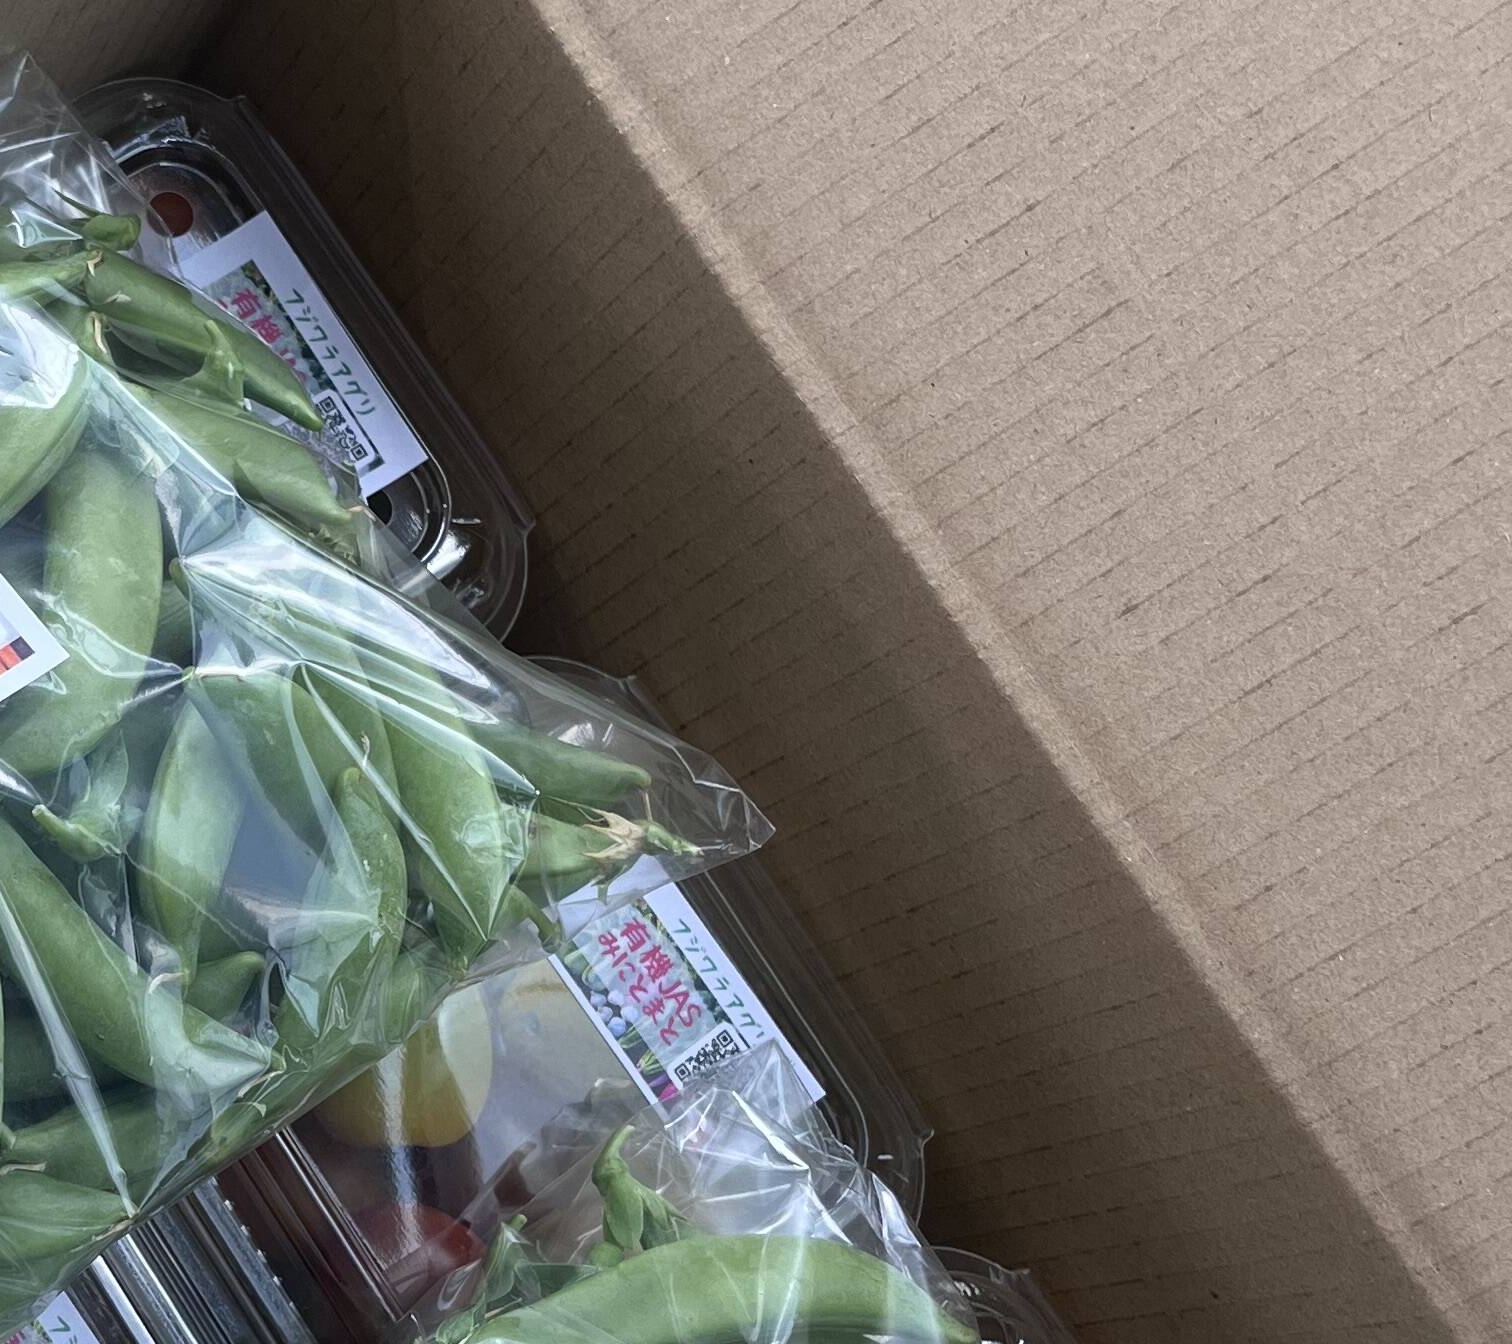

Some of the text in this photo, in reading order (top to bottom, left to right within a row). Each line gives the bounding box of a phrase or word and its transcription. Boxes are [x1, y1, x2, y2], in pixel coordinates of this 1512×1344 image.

[285, 288, 376, 415] フジワラアグリ
[598, 931, 678, 1045] みにとまと
[620, 918, 701, 1028] 有機JAS
